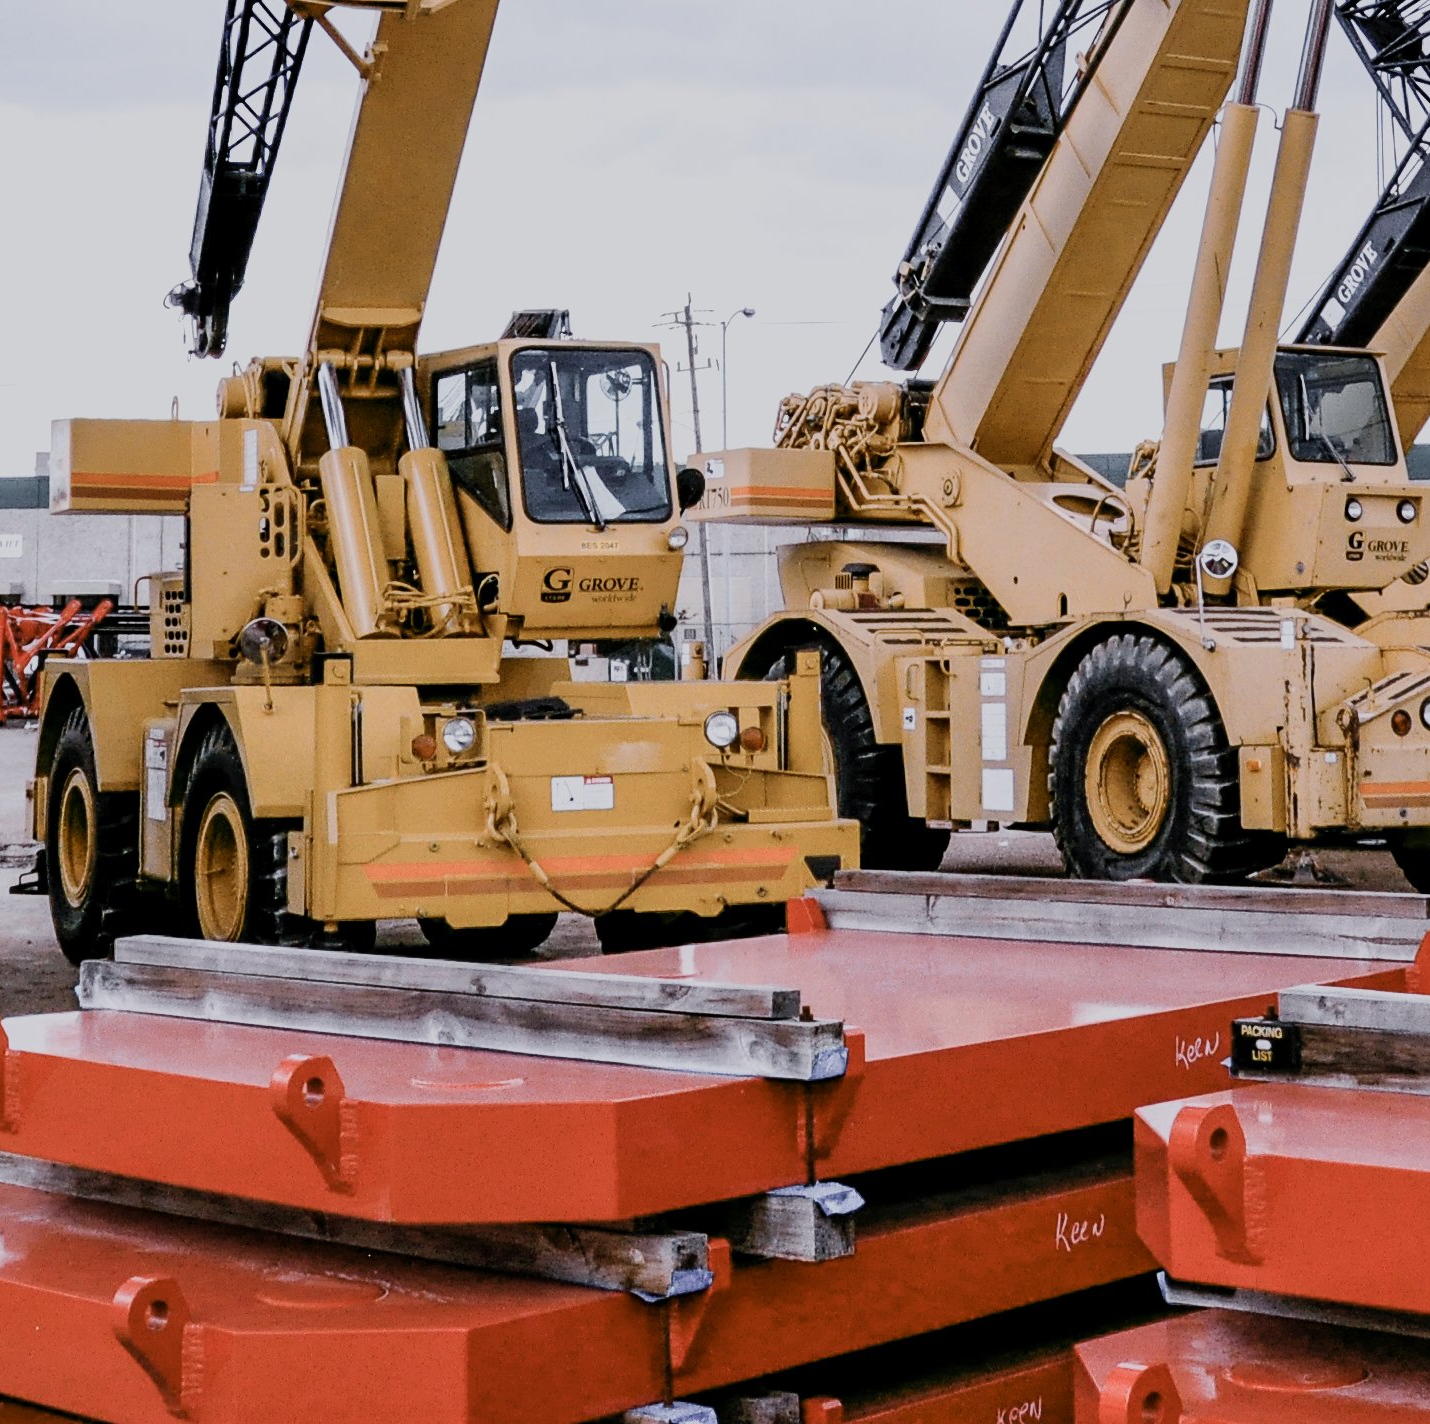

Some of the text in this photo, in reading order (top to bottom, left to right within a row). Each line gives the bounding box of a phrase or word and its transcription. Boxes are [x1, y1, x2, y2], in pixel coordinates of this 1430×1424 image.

[956, 102, 996, 183] GROVE
[1338, 240, 1378, 303] GROVE
[1349, 531, 1410, 553] G GROVE
[544, 568, 639, 592] G GROVE
[1241, 1024, 1283, 1039] PACKING
[1252, 1049, 1273, 1062] LIST
